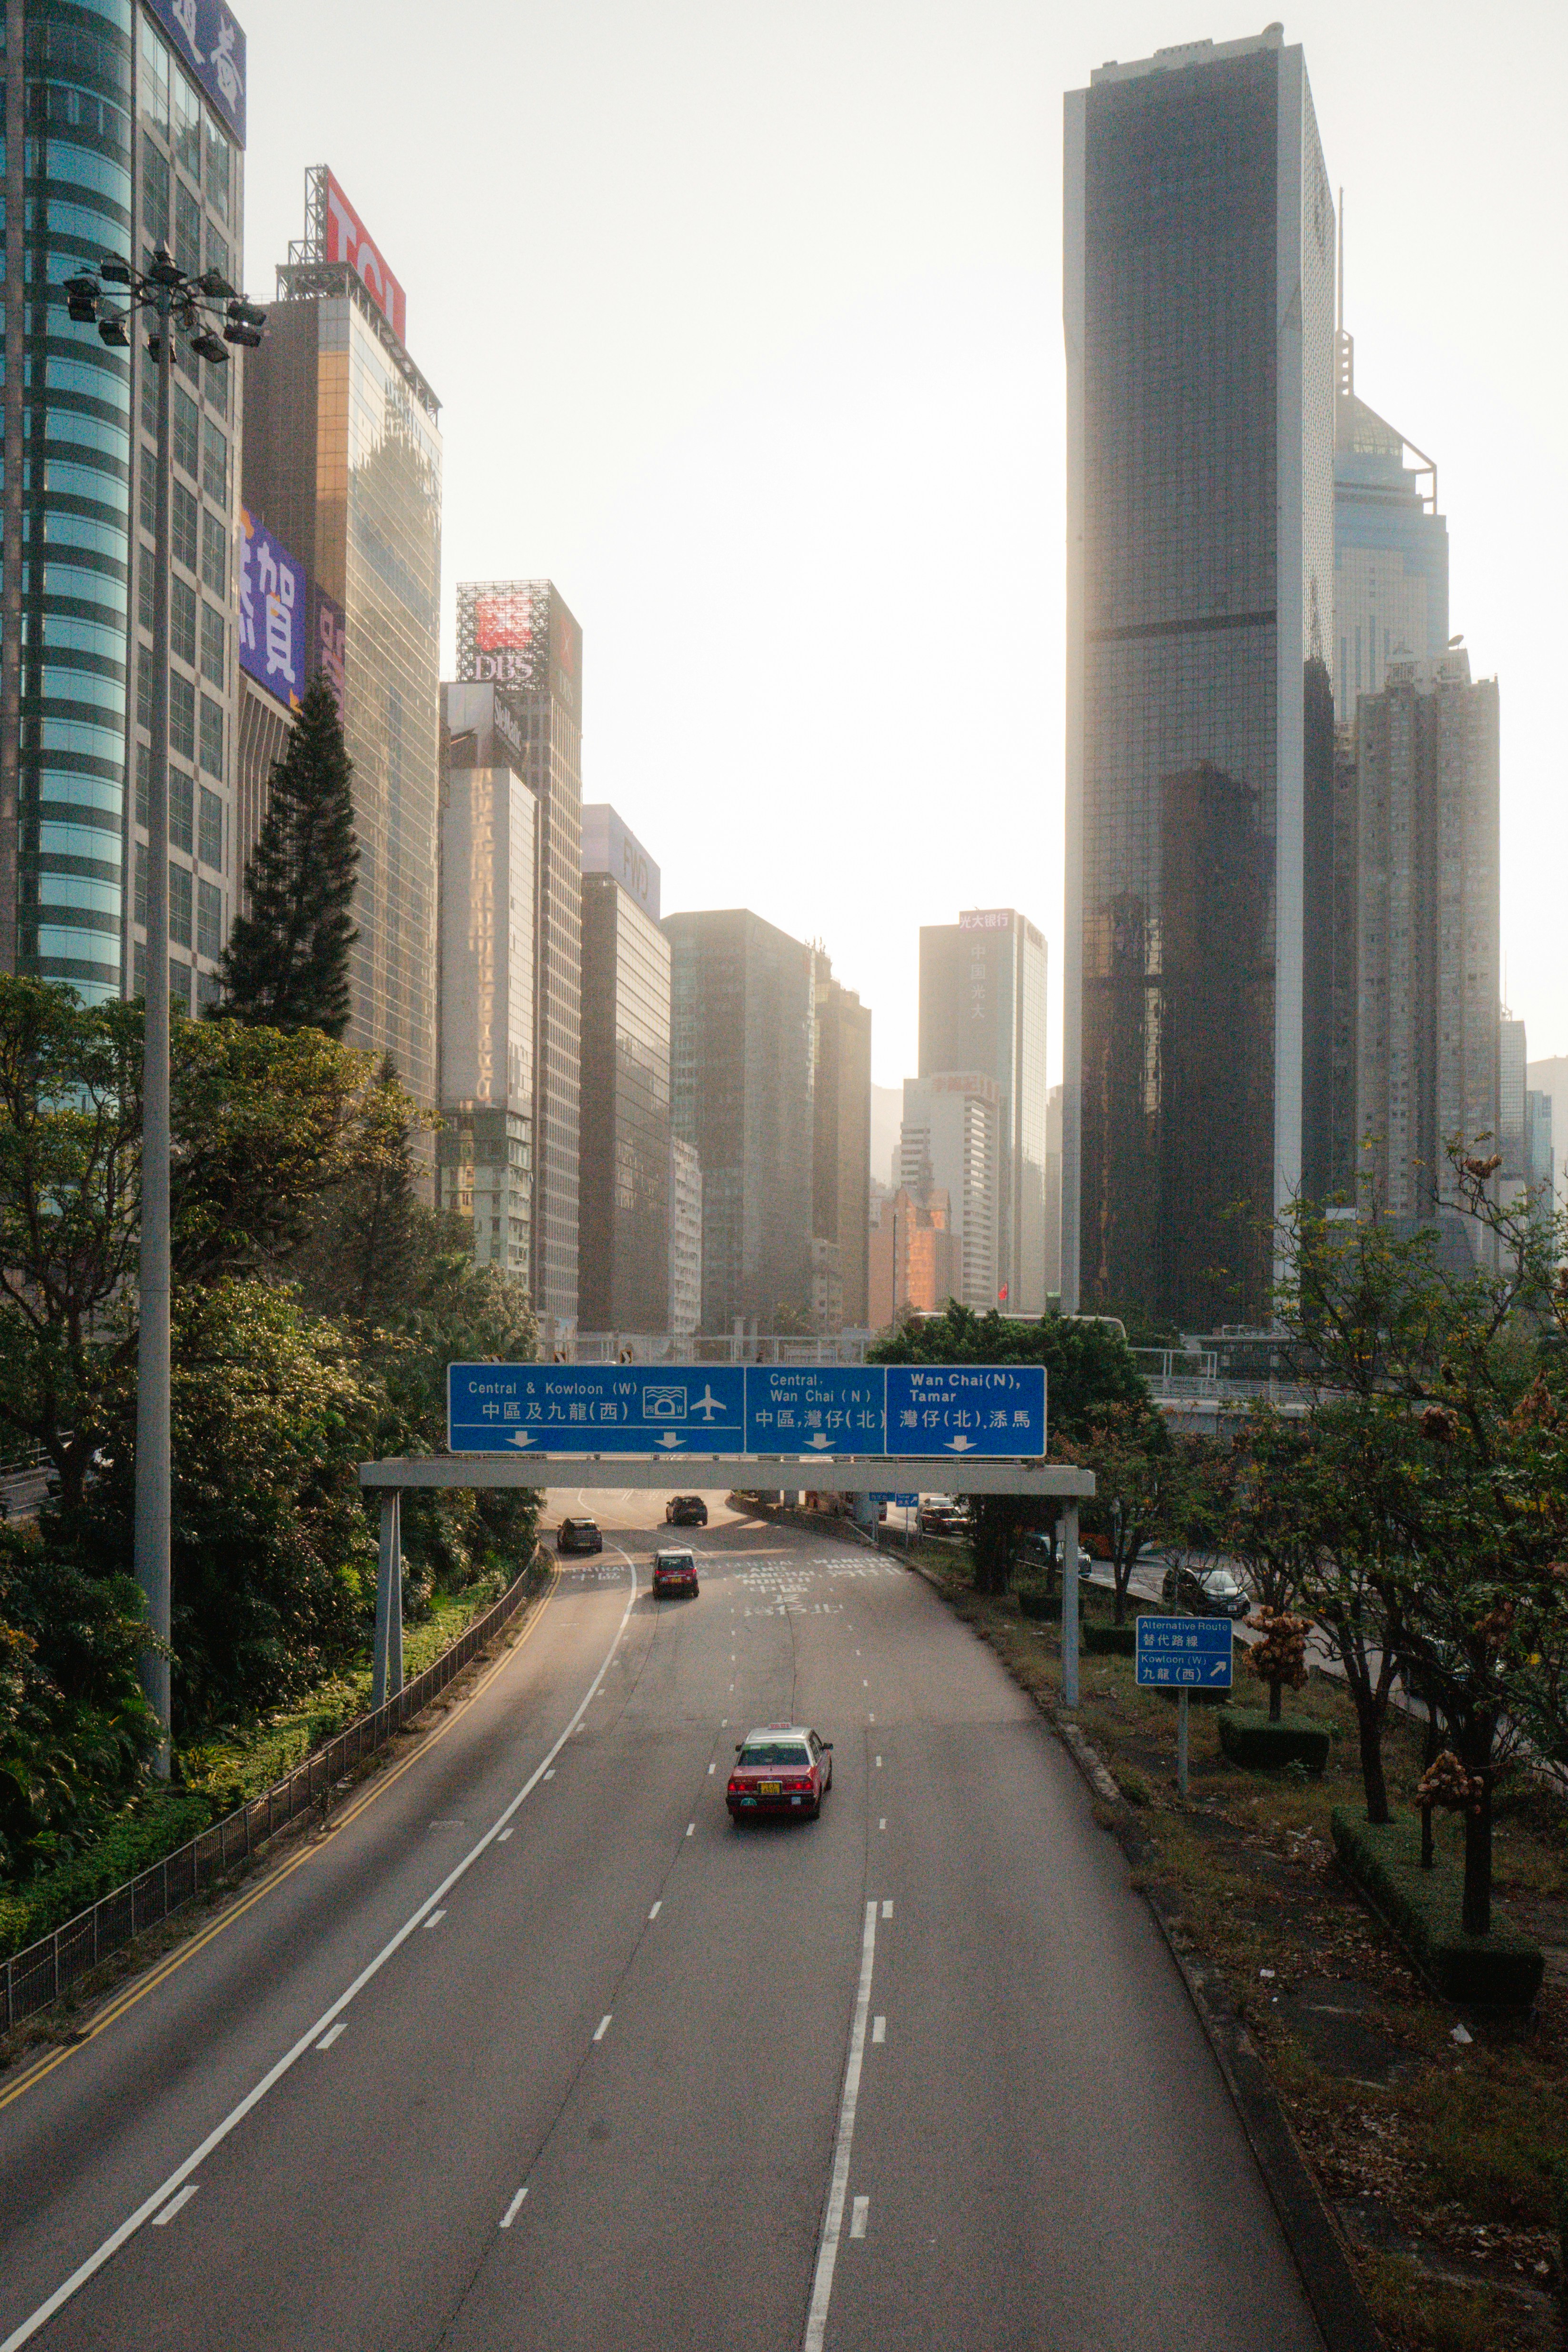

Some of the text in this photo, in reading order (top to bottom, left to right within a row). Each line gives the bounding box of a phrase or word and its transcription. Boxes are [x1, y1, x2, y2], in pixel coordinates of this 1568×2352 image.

[476, 654, 532, 680] DBS
[623, 836, 648, 900] FWD
[959, 913, 1009, 928] 光大银行
[910, 1374, 943, 1386] Wan
[469, 1382, 637, 1395] Central & Kowloon (W)
[770, 1390, 798, 1402] Wan
[805, 1390, 834, 1402] Chai
[910, 1390, 956, 1402] Tamar
[482, 1401, 628, 1421] 中區及九龍(西)
[645, 1405, 654, 1413] 西
[677, 1405, 683, 1414] W
[1142, 1621, 1228, 1631] Alternative Route
[1143, 1634, 1198, 1647] 替代路線
[1141, 1654, 1207, 1665] Kowloon (W)
[1143, 1667, 1201, 1683] 九龍(西)
